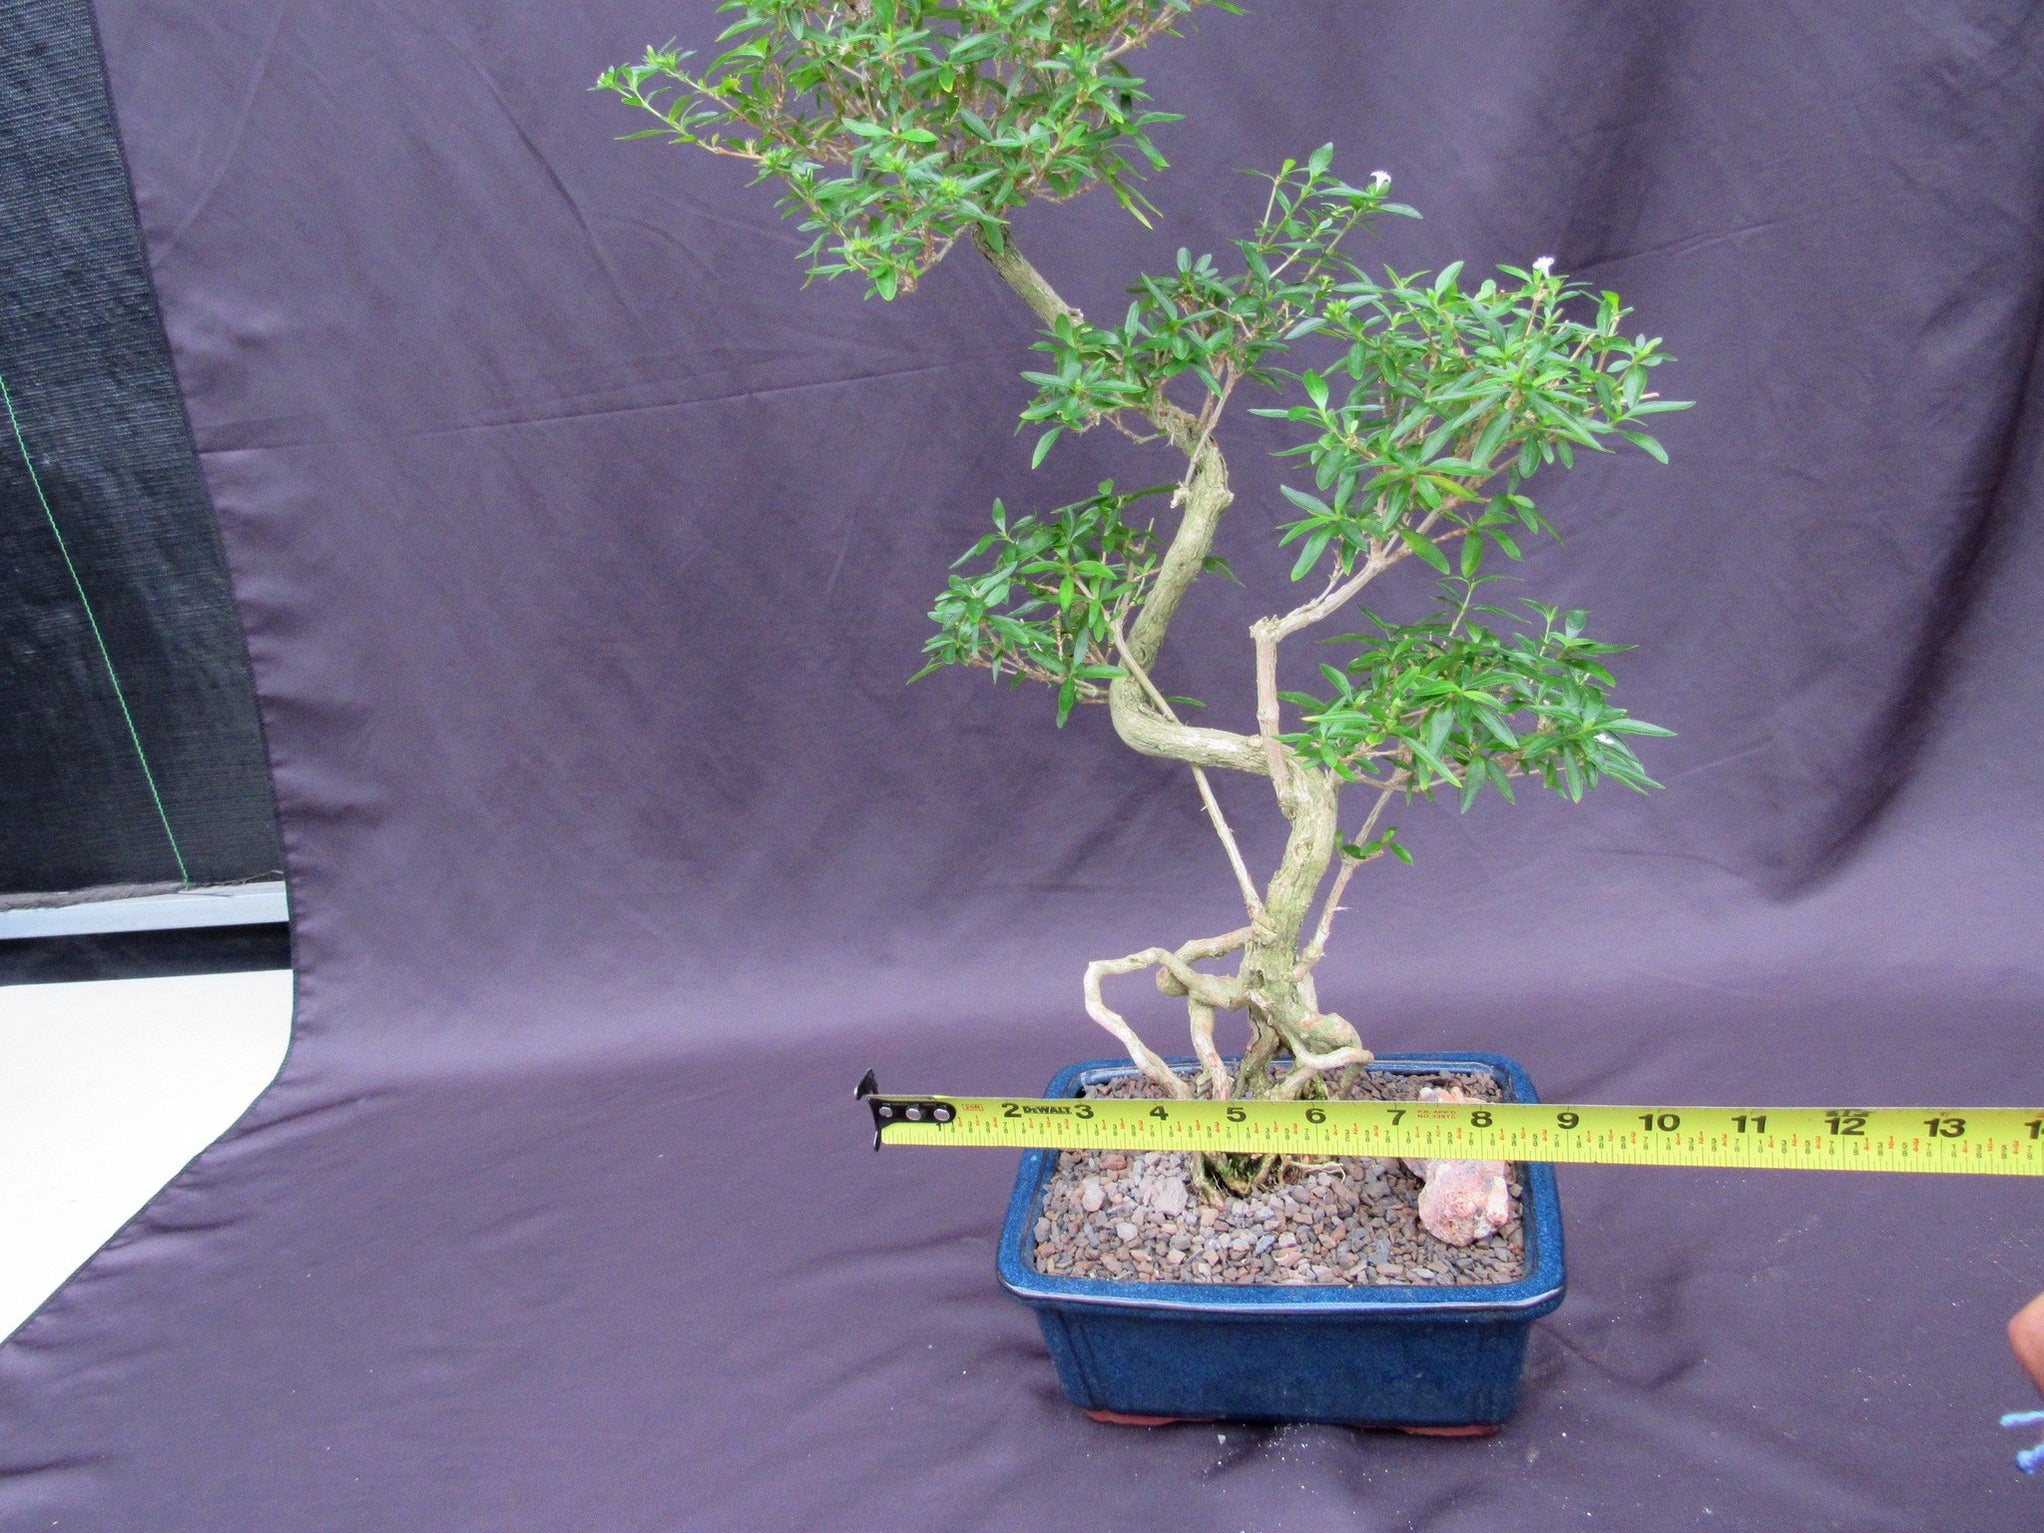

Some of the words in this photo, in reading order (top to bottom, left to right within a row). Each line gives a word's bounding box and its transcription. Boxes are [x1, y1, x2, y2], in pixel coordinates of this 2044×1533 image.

[1001, 1103, 1022, 1118] 2
[1074, 1104, 1094, 1119] 3
[1149, 1105, 1169, 1121] 4
[1226, 1107, 1246, 1122] 5
[1305, 1108, 1327, 1124] 6
[1386, 1109, 1407, 1126] 7
[1470, 1111, 1493, 1128] 8
[1556, 1112, 1580, 1130] 9
[1638, 1113, 1681, 1132] 10
[1731, 1115, 1767, 1134] 11
[1824, 1117, 1867, 1136] 12
[1923, 1118, 1966, 1138] 13
[2024, 1120, 2044, 1140] 1
